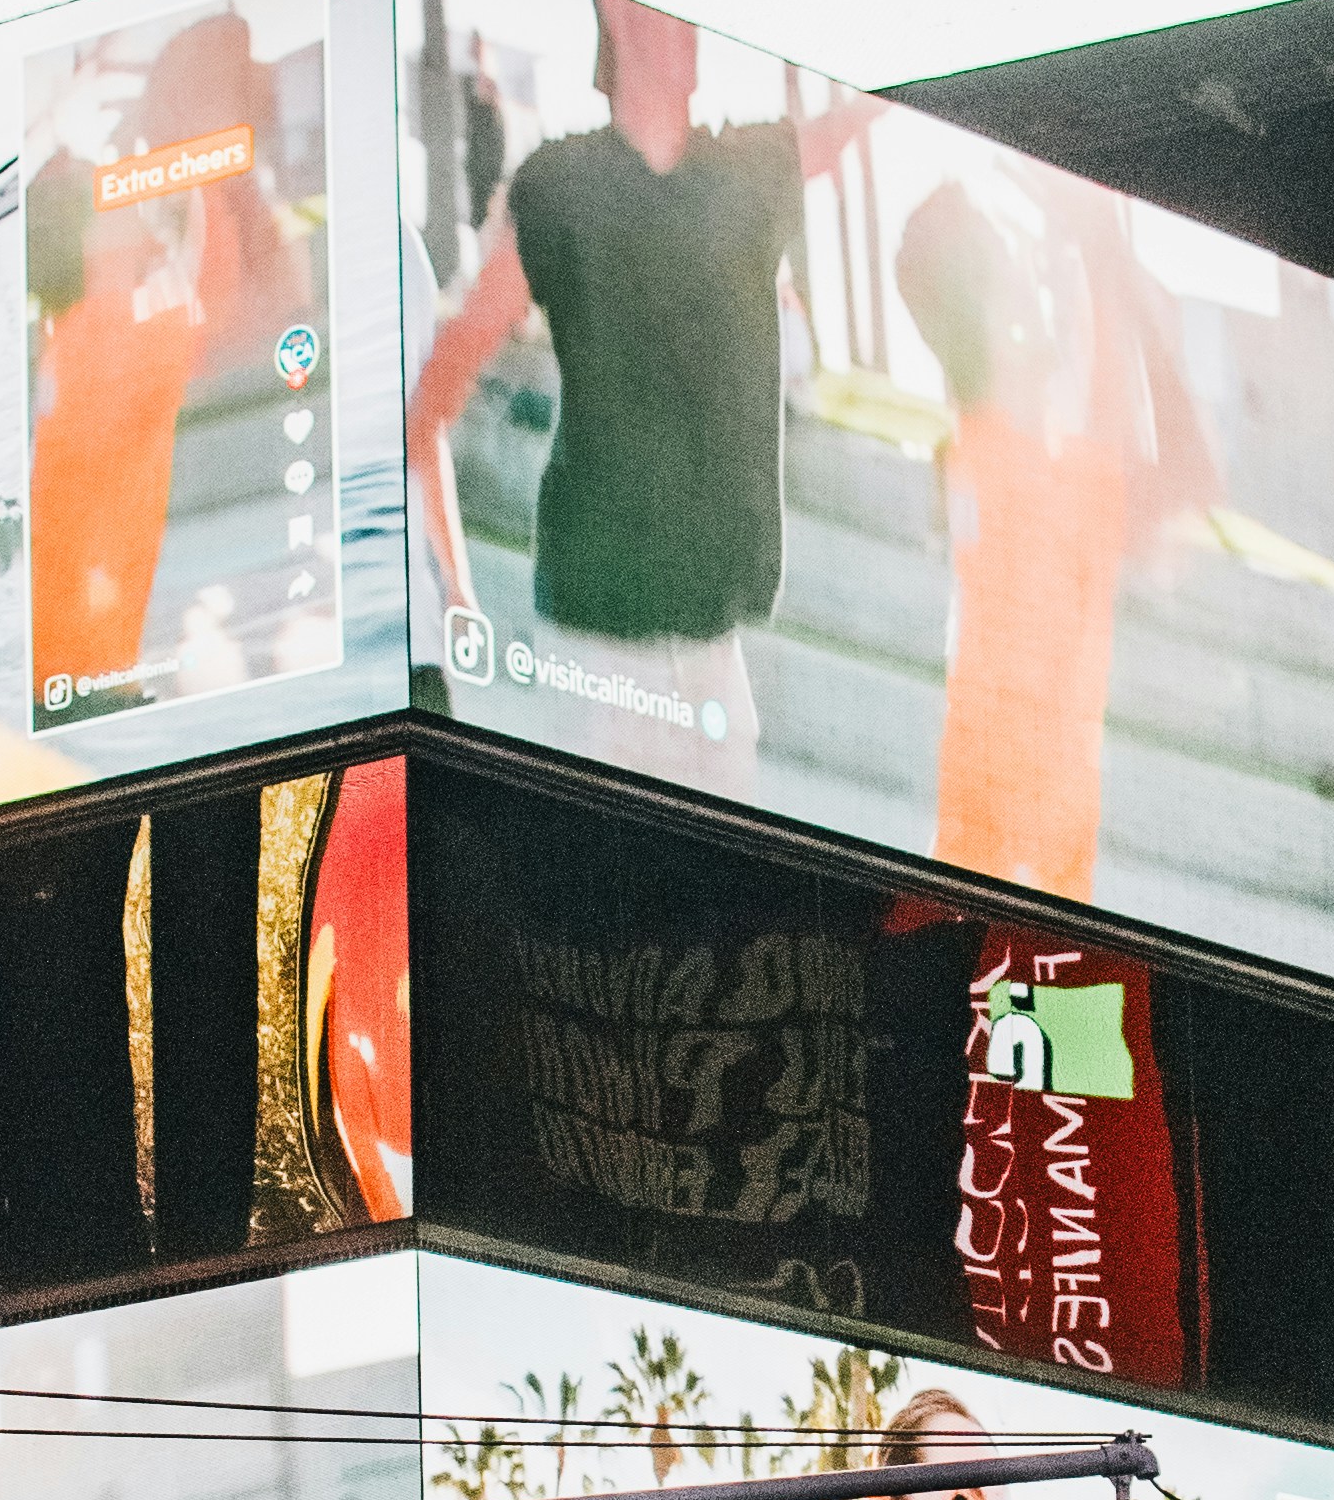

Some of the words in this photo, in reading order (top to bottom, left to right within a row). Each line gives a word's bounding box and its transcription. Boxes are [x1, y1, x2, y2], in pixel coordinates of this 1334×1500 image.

[101, 160, 165, 204] Extra
[168, 138, 248, 186] cheers
[505, 641, 695, 729] @visitcalifornia
